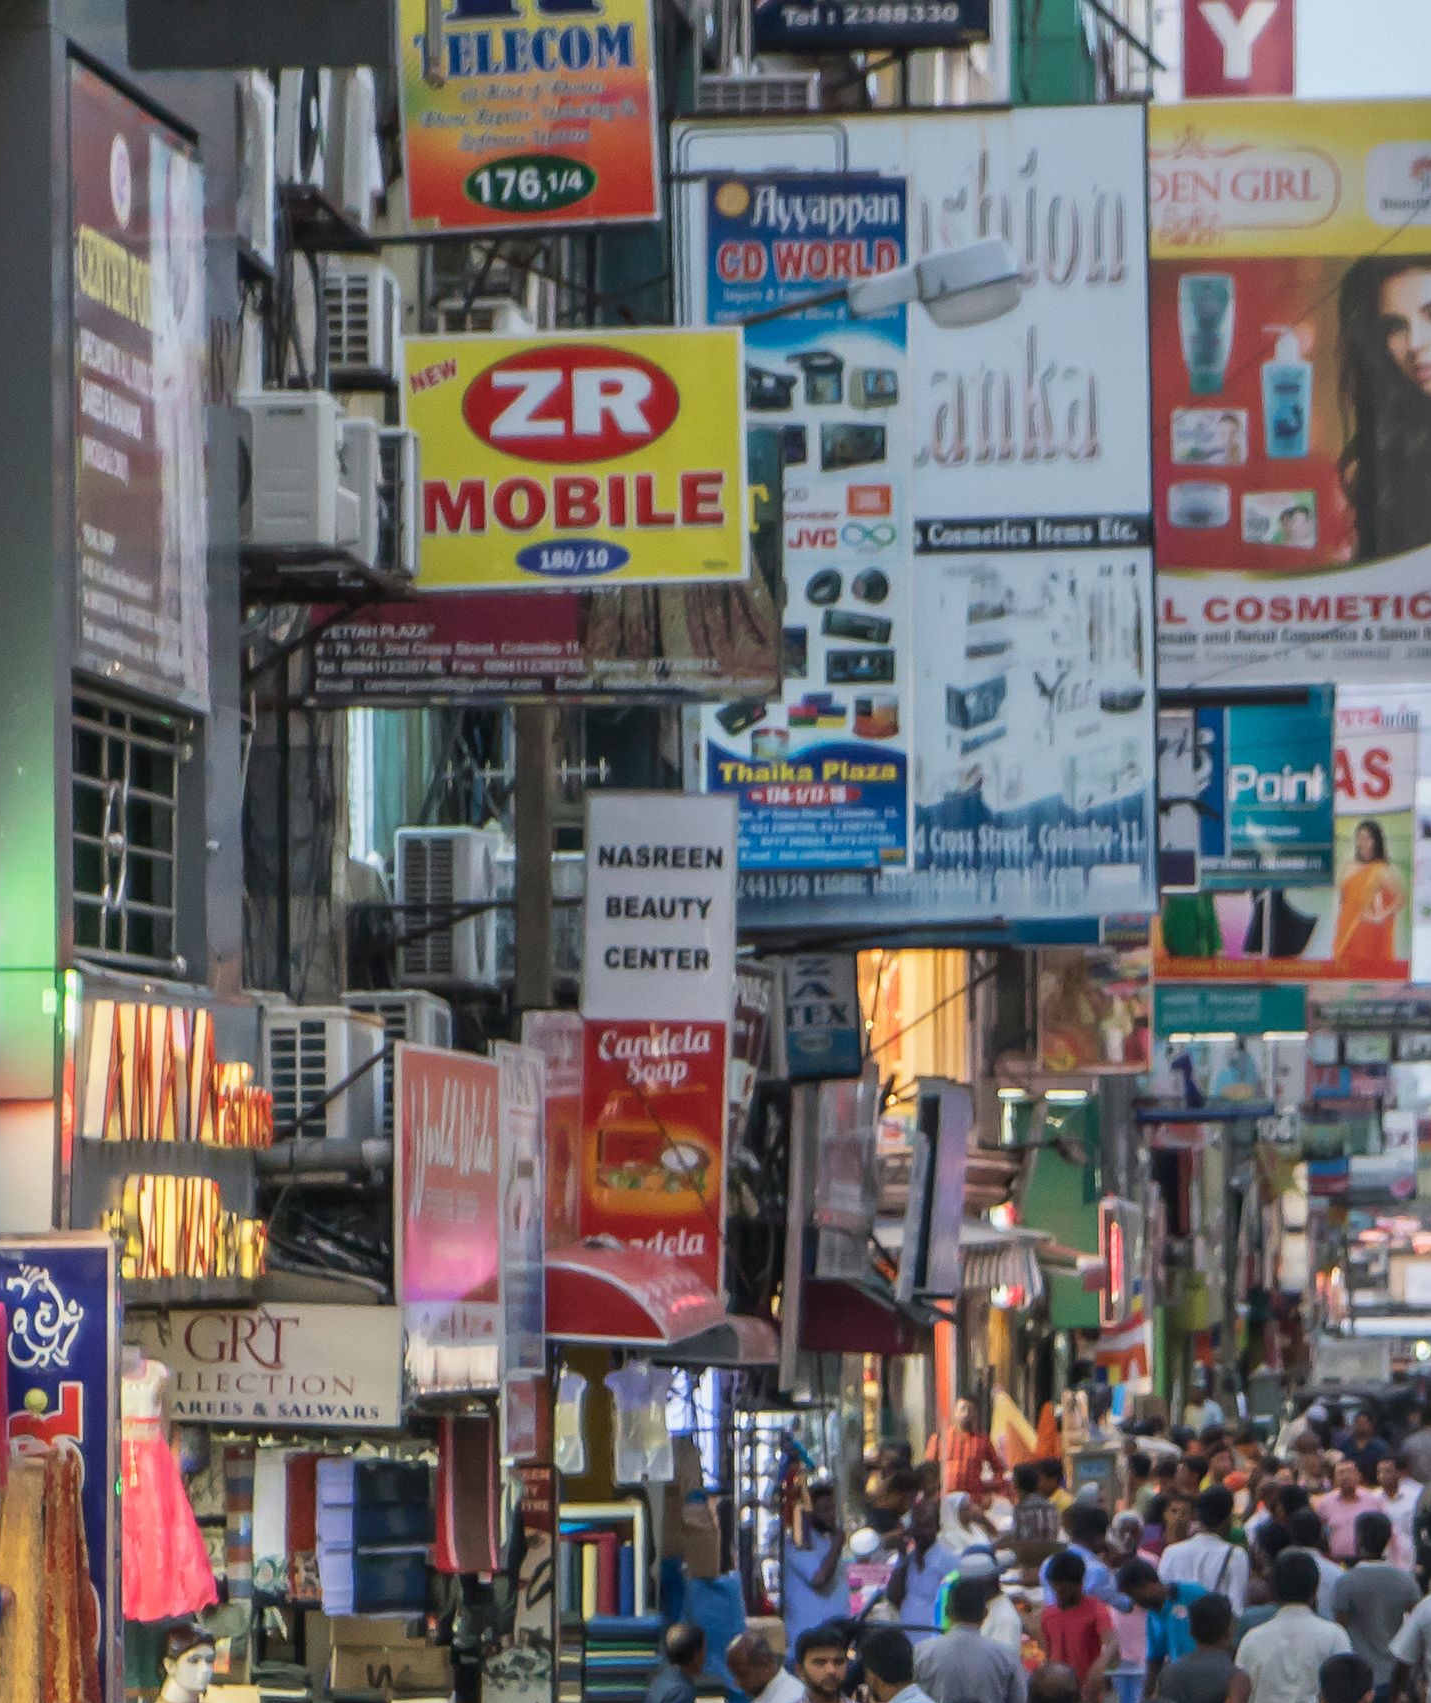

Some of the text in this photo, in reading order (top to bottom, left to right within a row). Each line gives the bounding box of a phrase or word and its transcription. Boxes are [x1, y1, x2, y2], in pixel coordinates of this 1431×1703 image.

[1231, 168, 1321, 202] GIRL
[750, 184, 900, 236] Ayyappan
[716, 238, 900, 283] CD WORLD
[410, 358, 459, 393] NEW
[488, 366, 655, 440] ZR
[423, 471, 726, 536] MOBILE
[787, 527, 838, 549] JVC
[822, 760, 898, 782] Plaza
[1229, 762, 1327, 803] Point
[597, 844, 724, 870] NASREEN
[605, 896, 712, 920] BEAUTY
[604, 947, 710, 971] CENTER
[597, 1026, 712, 1064] Candela
[627, 1056, 689, 1087] Soap
[185, 1314, 300, 1369] GRT
[175, 1374, 357, 1399] LLECTION
[175, 1401, 245, 1421] AREES
[275, 1401, 381, 1421] SALWARS
